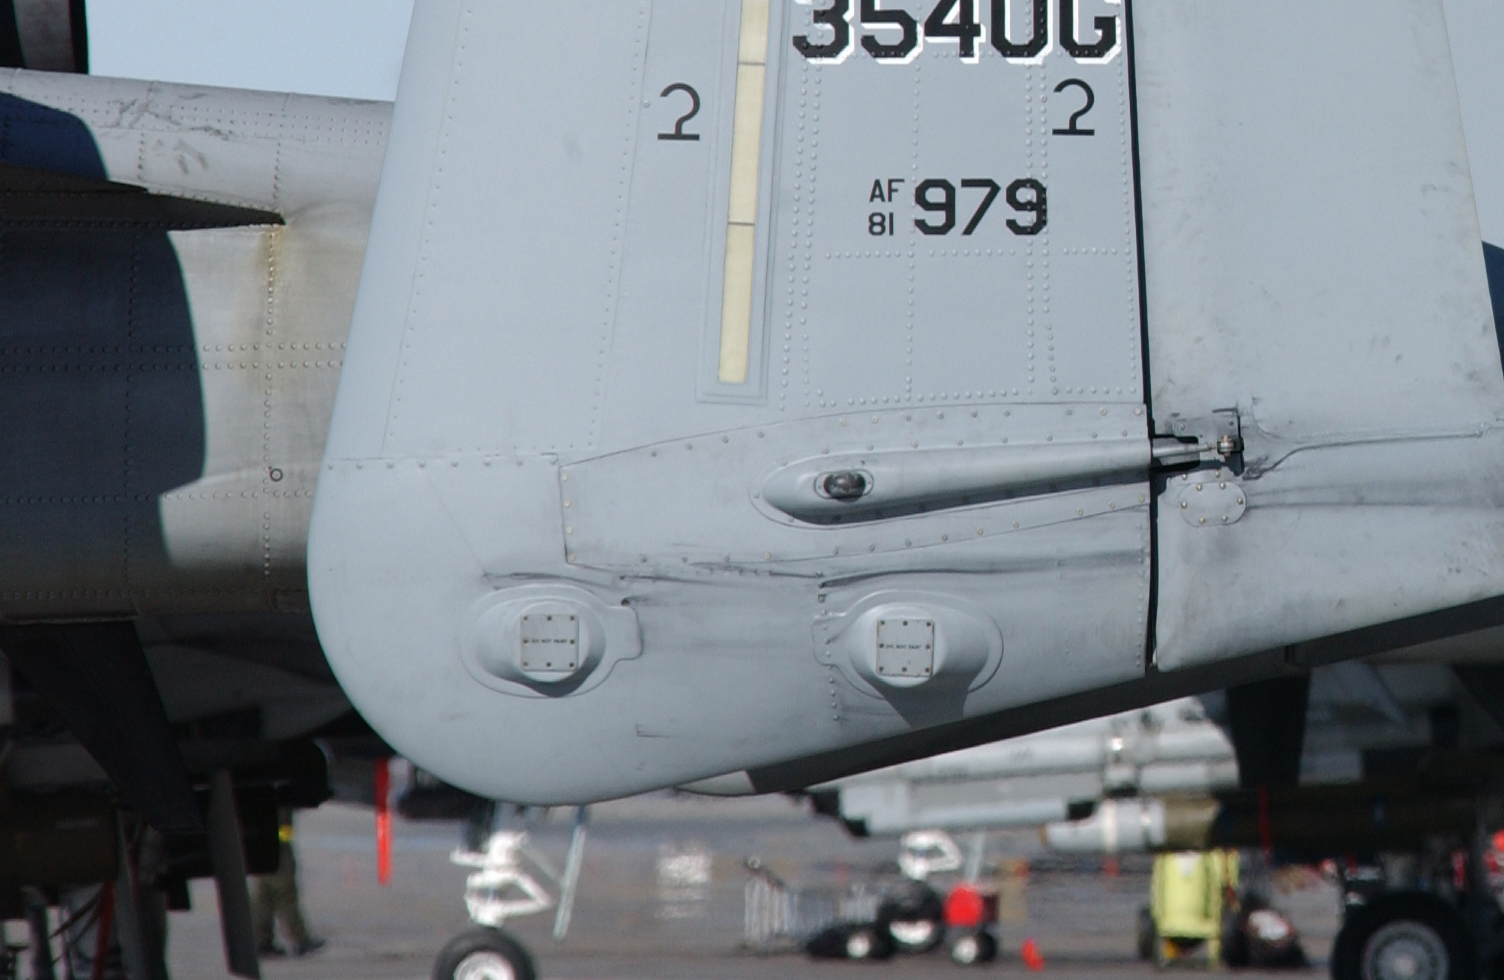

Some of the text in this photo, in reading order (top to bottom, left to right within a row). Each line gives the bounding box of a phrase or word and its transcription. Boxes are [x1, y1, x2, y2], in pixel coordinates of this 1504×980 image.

[657, 83, 701, 142] 2
[1052, 78, 1096, 136] 2
[869, 178, 905, 203] AF
[914, 178, 1047, 236] 979
